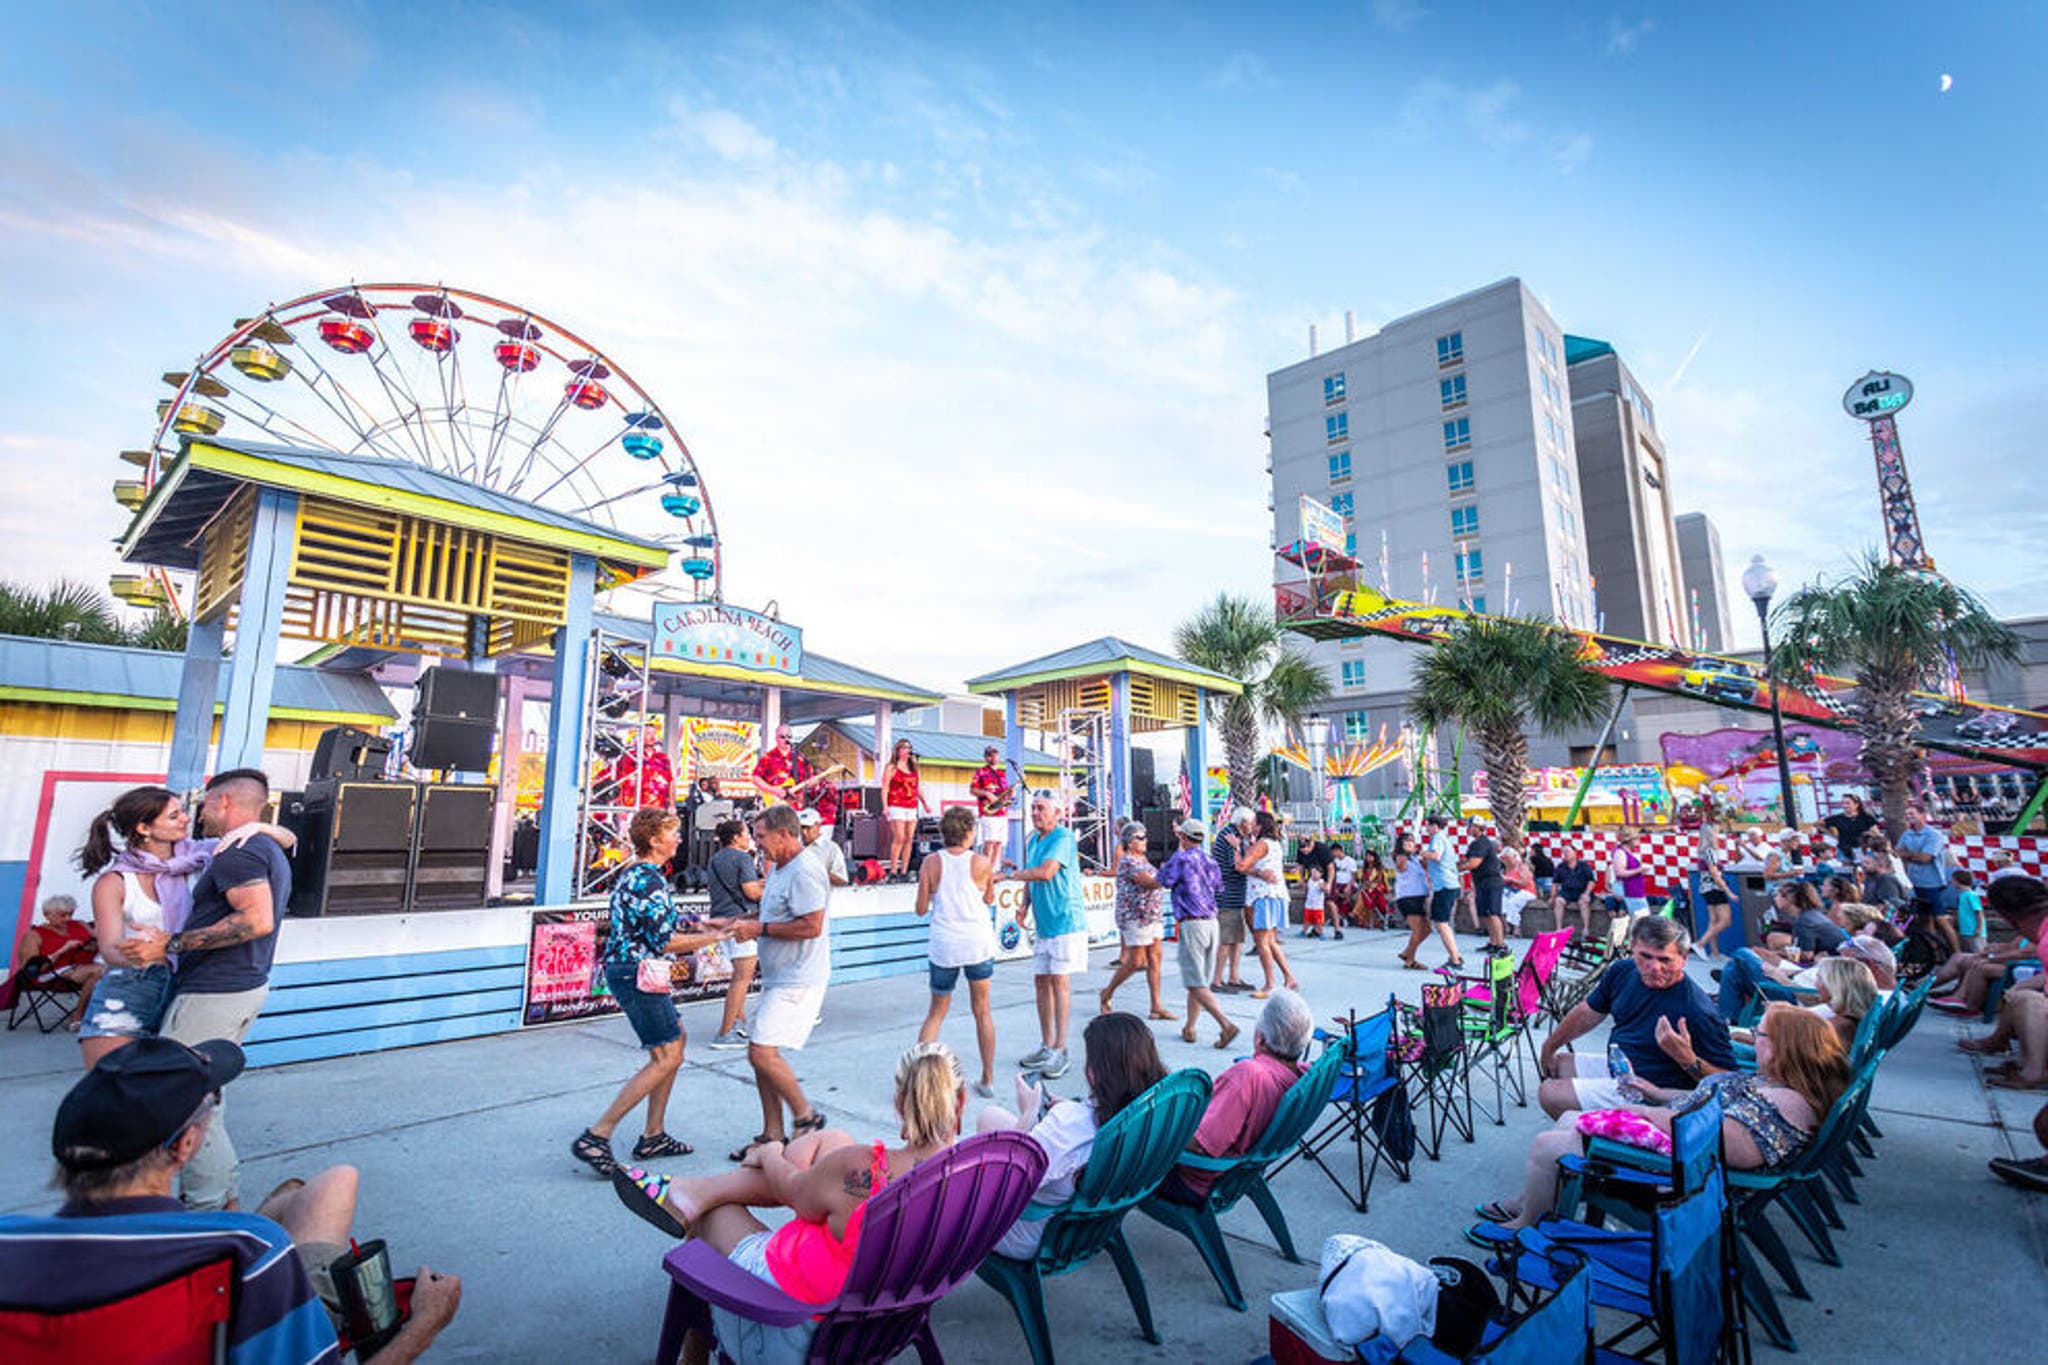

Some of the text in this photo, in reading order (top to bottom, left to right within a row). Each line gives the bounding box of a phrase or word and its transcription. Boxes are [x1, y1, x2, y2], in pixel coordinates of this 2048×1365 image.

[663, 606, 793, 652] CAROLINA BEACH
[573, 910, 609, 922] YOUR
